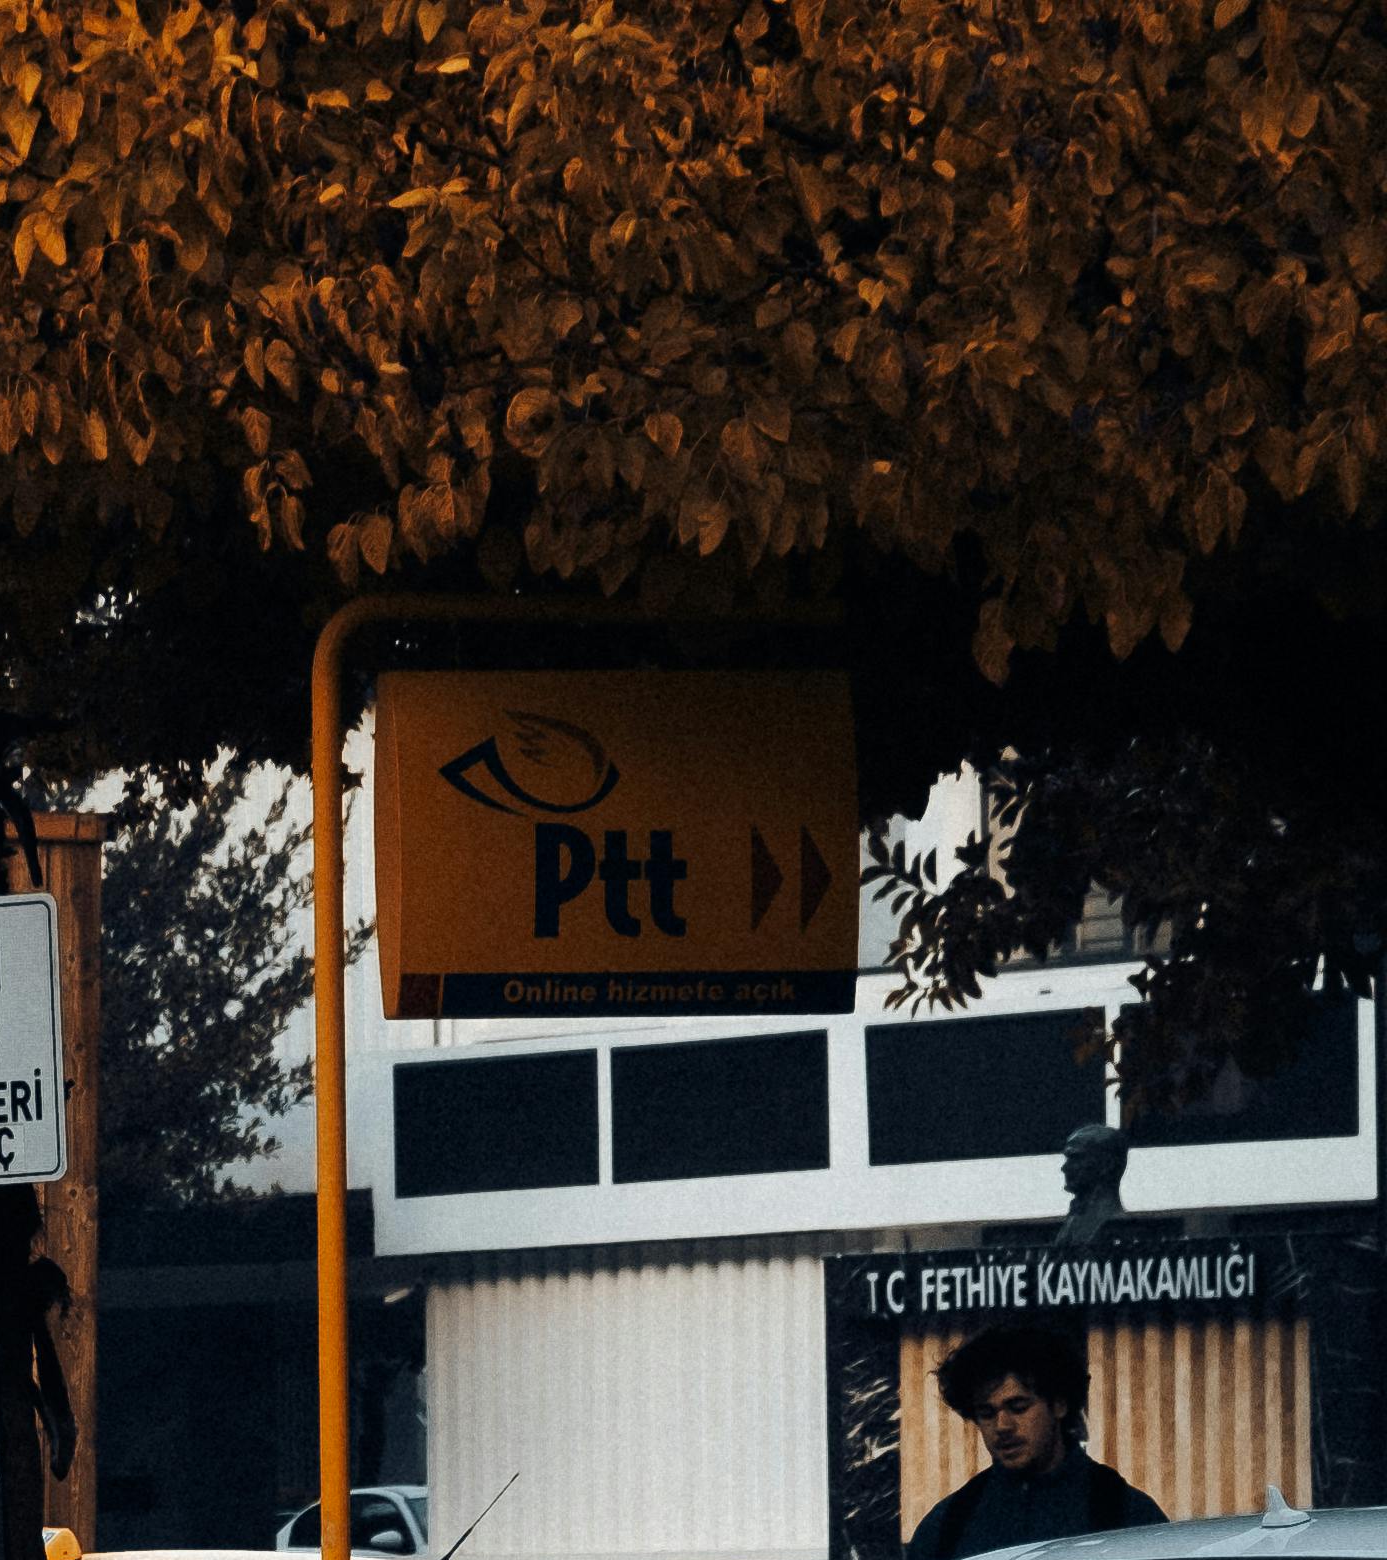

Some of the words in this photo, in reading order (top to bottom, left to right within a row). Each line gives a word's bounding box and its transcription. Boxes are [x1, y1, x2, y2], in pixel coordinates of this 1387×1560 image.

[533, 822, 688, 939] Ptt
[503, 979, 601, 1003] Online
[736, 979, 796, 1005] açık
[921, 1253, 1027, 1312] FETHİYE
[1037, 1242, 1255, 1305] KAYMAKAMLIĞI
